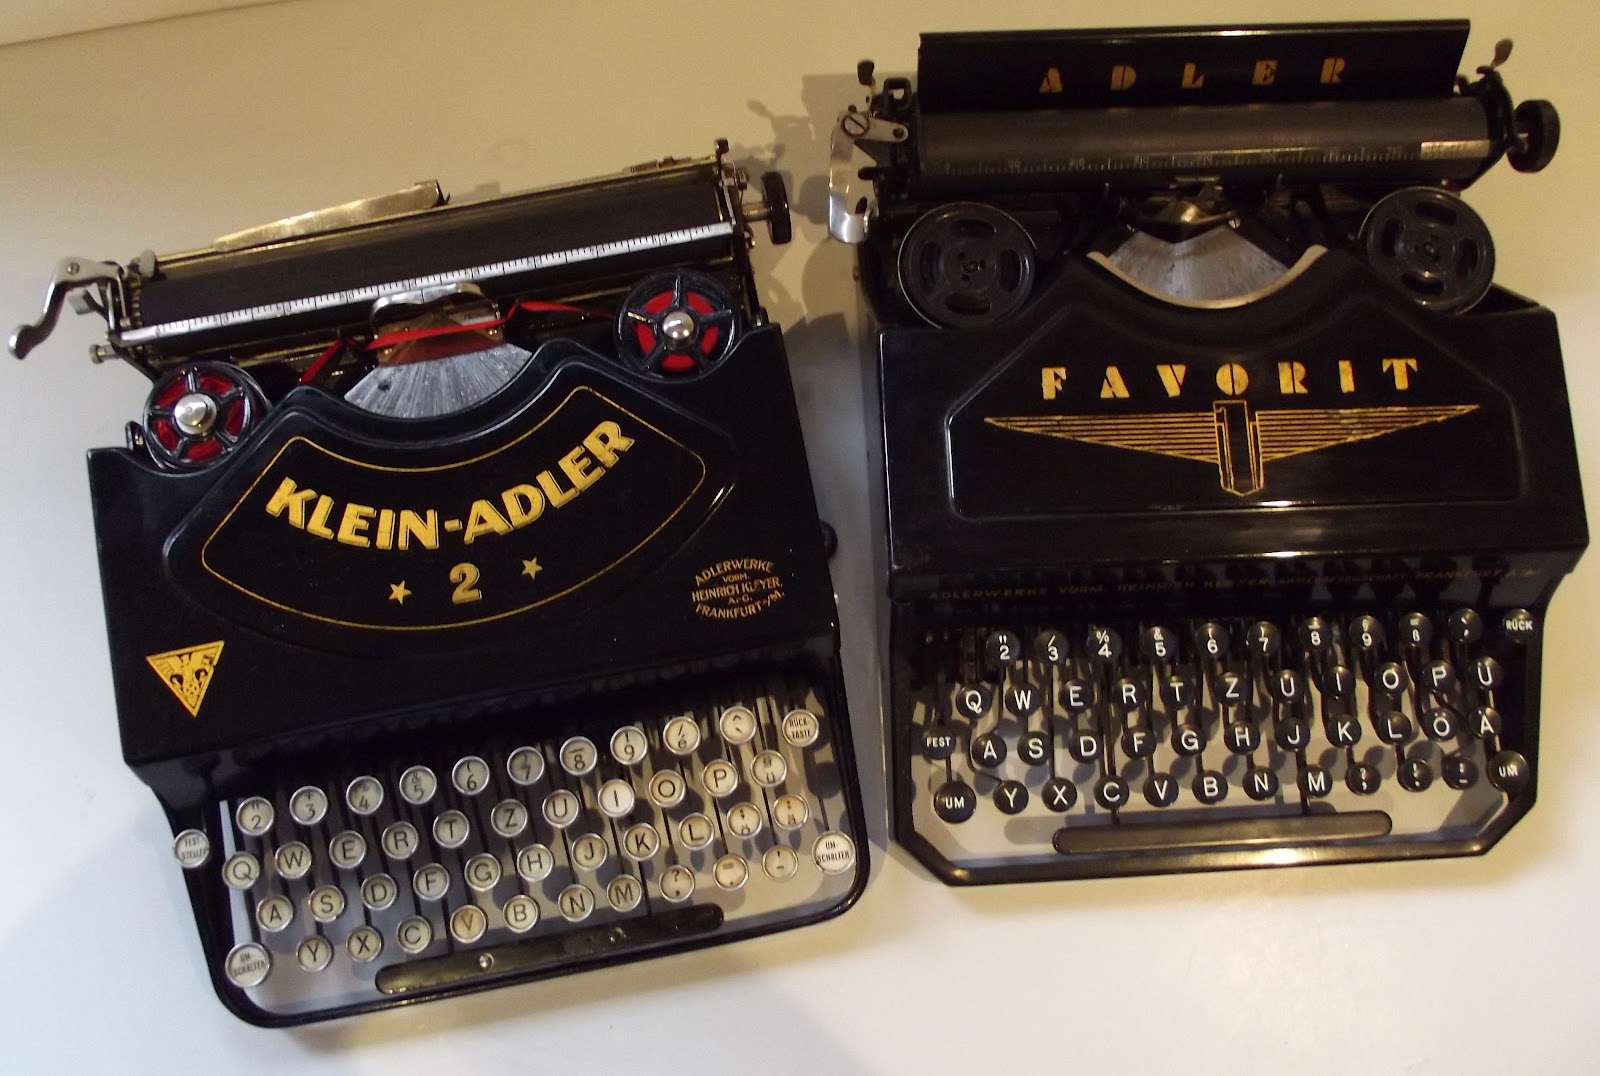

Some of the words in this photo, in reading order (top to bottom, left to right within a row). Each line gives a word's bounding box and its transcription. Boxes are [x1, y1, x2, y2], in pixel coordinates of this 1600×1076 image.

[1039, 57, 1346, 93] ADLER
[1041, 358, 1418, 399] FAVORIT
[265, 420, 635, 550] KLEIN-ADLER
[695, 558, 774, 586] ADLERWERKE
[449, 562, 482, 604] 2
[691, 583, 739, 602] HEINRICH
[1506, 617, 1533, 630] RÜCK
[1207, 639, 1218, 654] 6
[1259, 637, 1268, 652] 7
[1311, 631, 1321, 645] 8
[1362, 632, 1372, 646] 9
[1000, 645, 1010, 660] 2
[1049, 646, 1058, 661] 3
[1098, 644, 1112, 658] 4
[1156, 642, 1166, 657] 5
[1336, 673, 1341, 692] I
[1383, 671, 1399, 690] O
[1432, 666, 1446, 686] P
[1070, 686, 1083, 706] E
[1123, 683, 1136, 703] R
[1170, 682, 1183, 701] T
[1225, 678, 1239, 698] Z
[1280, 676, 1295, 697] U
[965, 690, 982, 713] Q
[1014, 690, 1032, 709] W
[1338, 721, 1353, 741] K
[1389, 720, 1402, 738] L
[1433, 711, 1450, 736] Ö
[1477, 710, 1494, 734] Ä
[926, 736, 950, 748] FEST
[1134, 732, 1146, 752] F
[1181, 730, 1199, 750] G
[1235, 727, 1250, 747] H
[1288, 725, 1300, 745] J
[624, 745, 635, 761] 9
[983, 740, 997, 759] A
[1029, 737, 1043, 757] S
[1081, 736, 1096, 756] D
[574, 754, 586, 770] 8
[1499, 765, 1518, 777] UM
[467, 774, 476, 791] 6
[713, 769, 726, 788] P
[1204, 777, 1218, 797] B
[1254, 773, 1268, 793] N
[1309, 771, 1324, 791] M
[413, 785, 424, 800] 5
[613, 790, 618, 807] I
[658, 780, 676, 799] O
[1004, 787, 1018, 808] Y
[1053, 785, 1068, 805] X
[1104, 782, 1120, 801] C
[1154, 780, 1168, 800] V
[306, 804, 316, 820] 3
[359, 795, 369, 810] 4
[552, 798, 567, 818] U
[945, 796, 964, 809] UM
[251, 815, 262, 830] 2
[505, 809, 517, 828] Z
[394, 830, 409, 849] R
[444, 821, 458, 839] T
[689, 824, 704, 841] L
[343, 840, 356, 861] E
[584, 843, 594, 861] J
[636, 834, 650, 851] K
[284, 851, 303, 870] W
[527, 854, 543, 870] H
[232, 860, 255, 881] Q
[474, 863, 492, 881] G
[426, 873, 438, 890] F
[372, 883, 387, 901] D
[614, 885, 633, 904] M
[269, 904, 282, 922] A
[320, 895, 333, 913] S
[514, 904, 527, 922] B
[570, 894, 585, 913] N
[462, 913, 473, 931] V
[404, 926, 421, 943] C
[309, 944, 320, 961] Y
[357, 935, 371, 955] X
